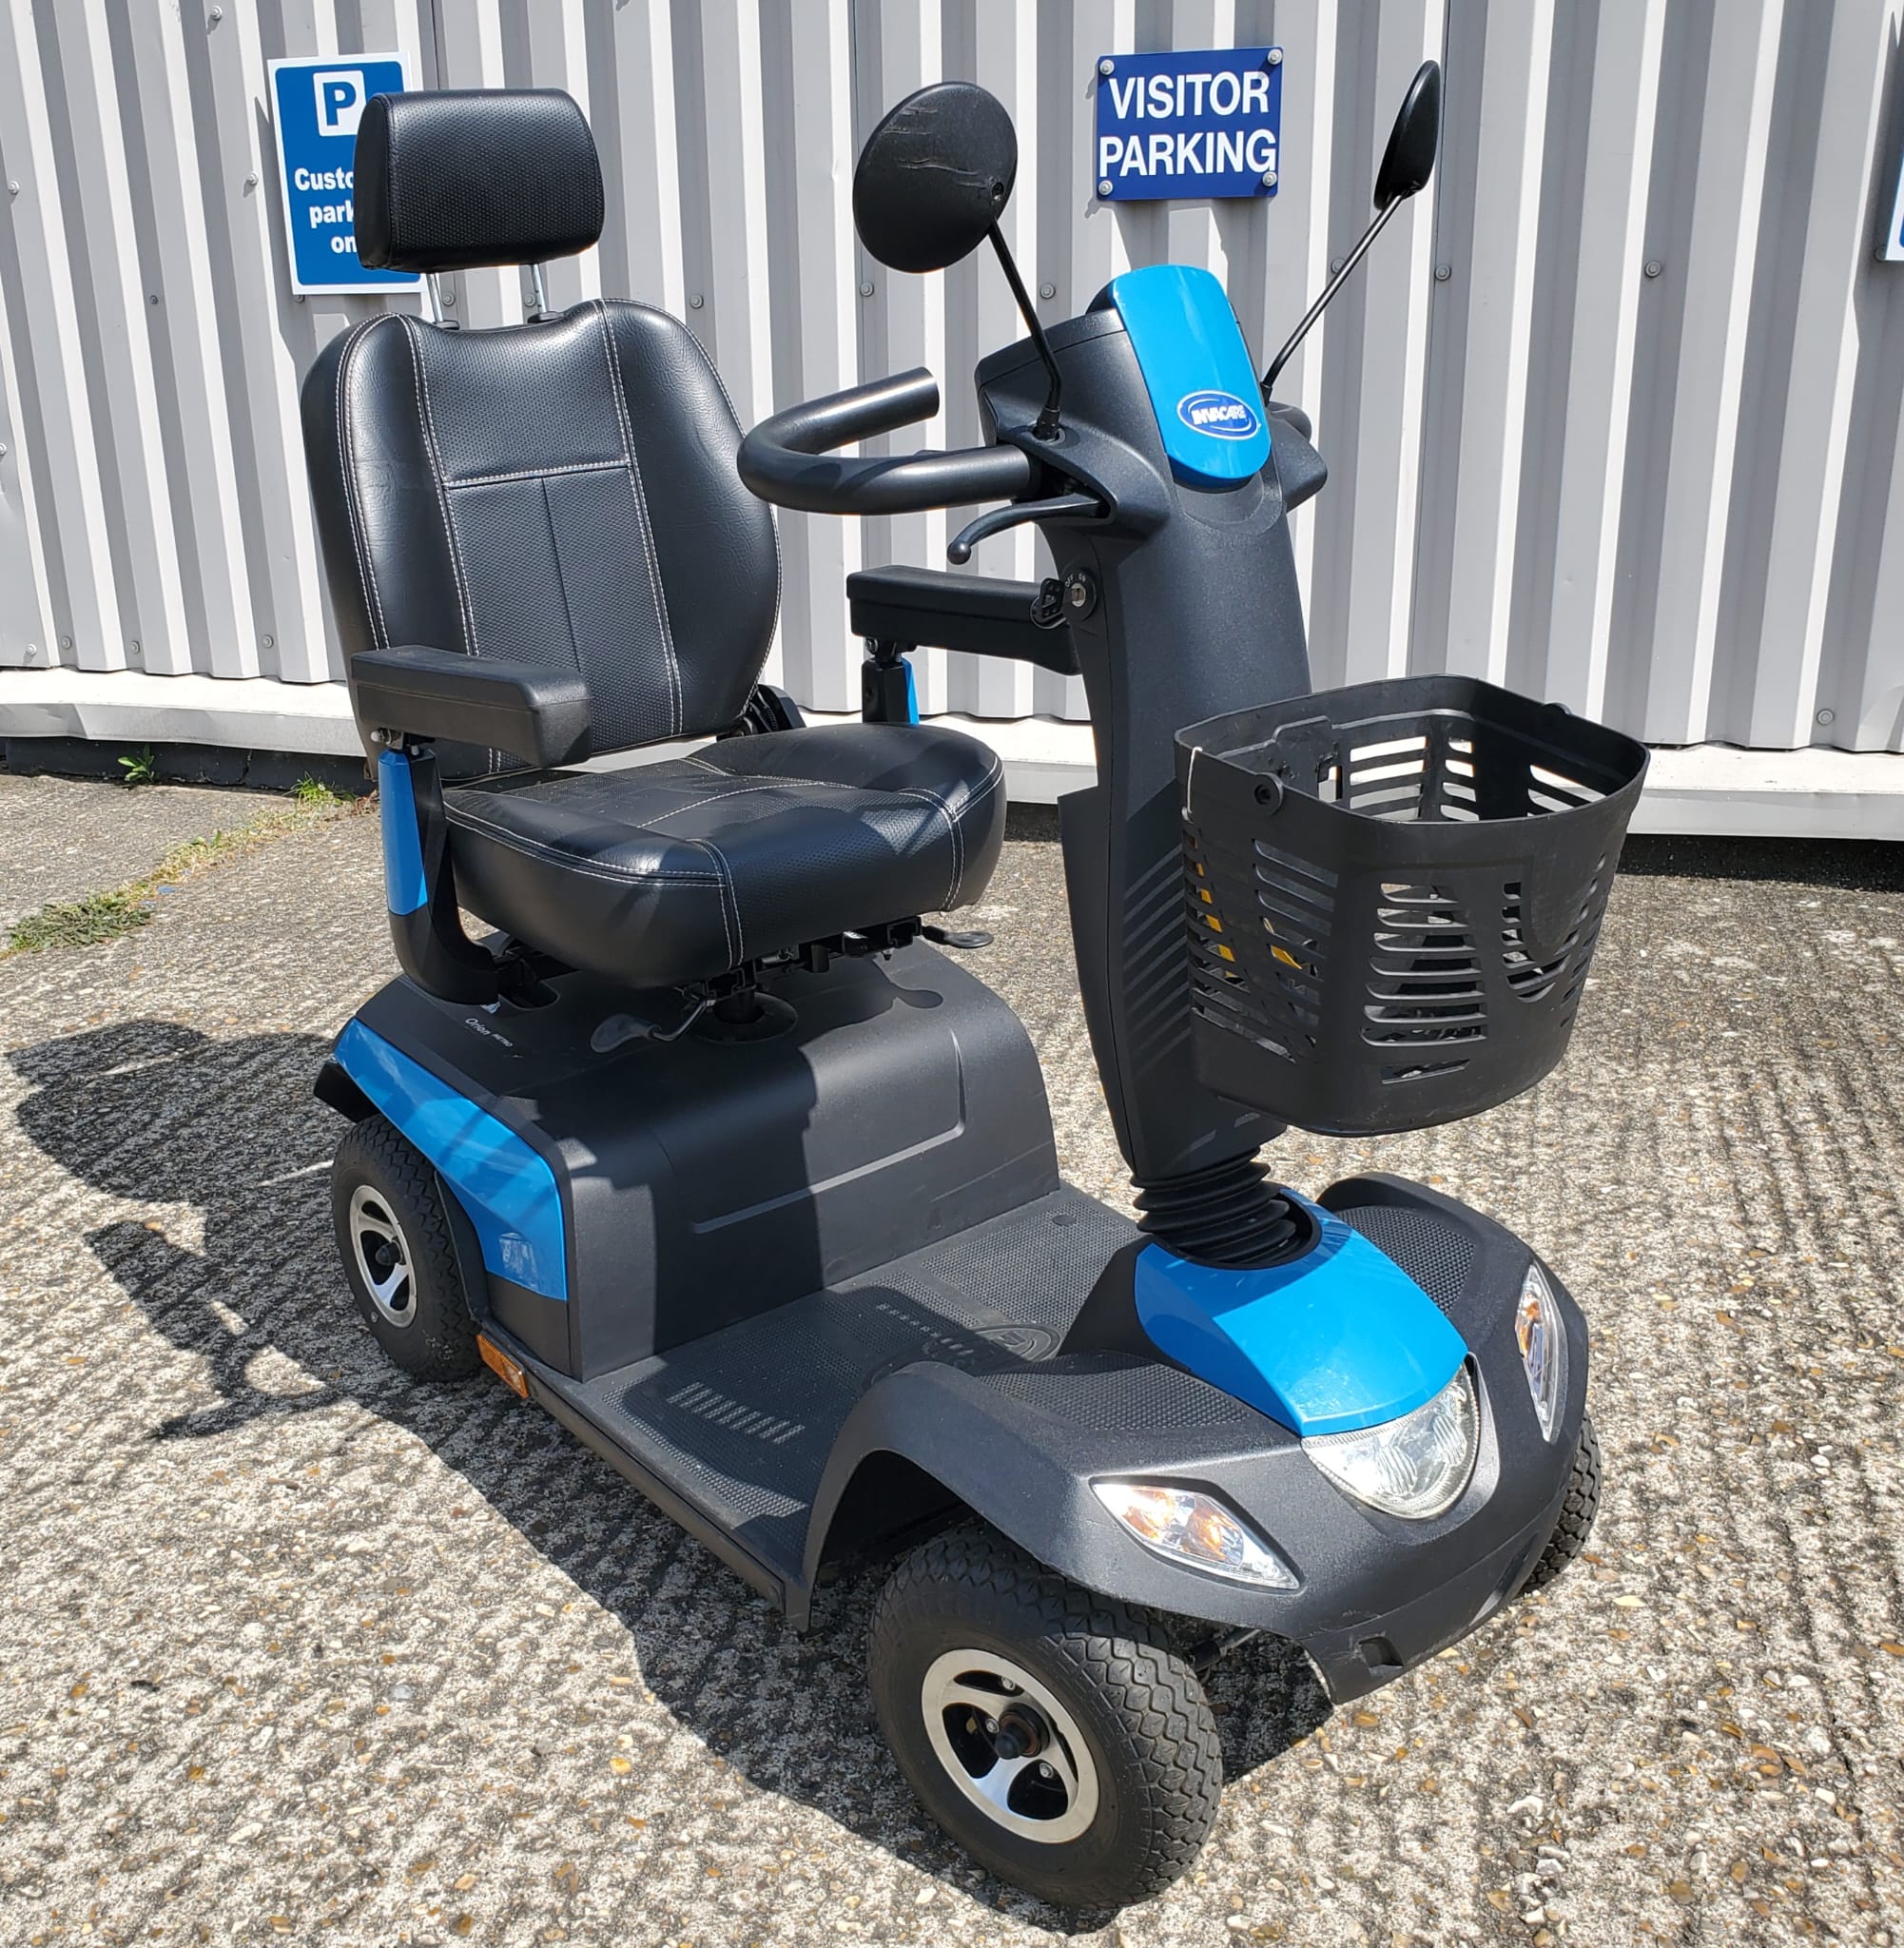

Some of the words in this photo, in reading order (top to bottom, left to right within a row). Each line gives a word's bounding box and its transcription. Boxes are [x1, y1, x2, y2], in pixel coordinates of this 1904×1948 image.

[322, 81, 357, 127] P
[1108, 71, 1270, 120] VISITOR
[1099, 128, 1276, 178] PARKING
[294, 167, 354, 191] Custo
[309, 200, 355, 229] park
[331, 236, 358, 254] on
